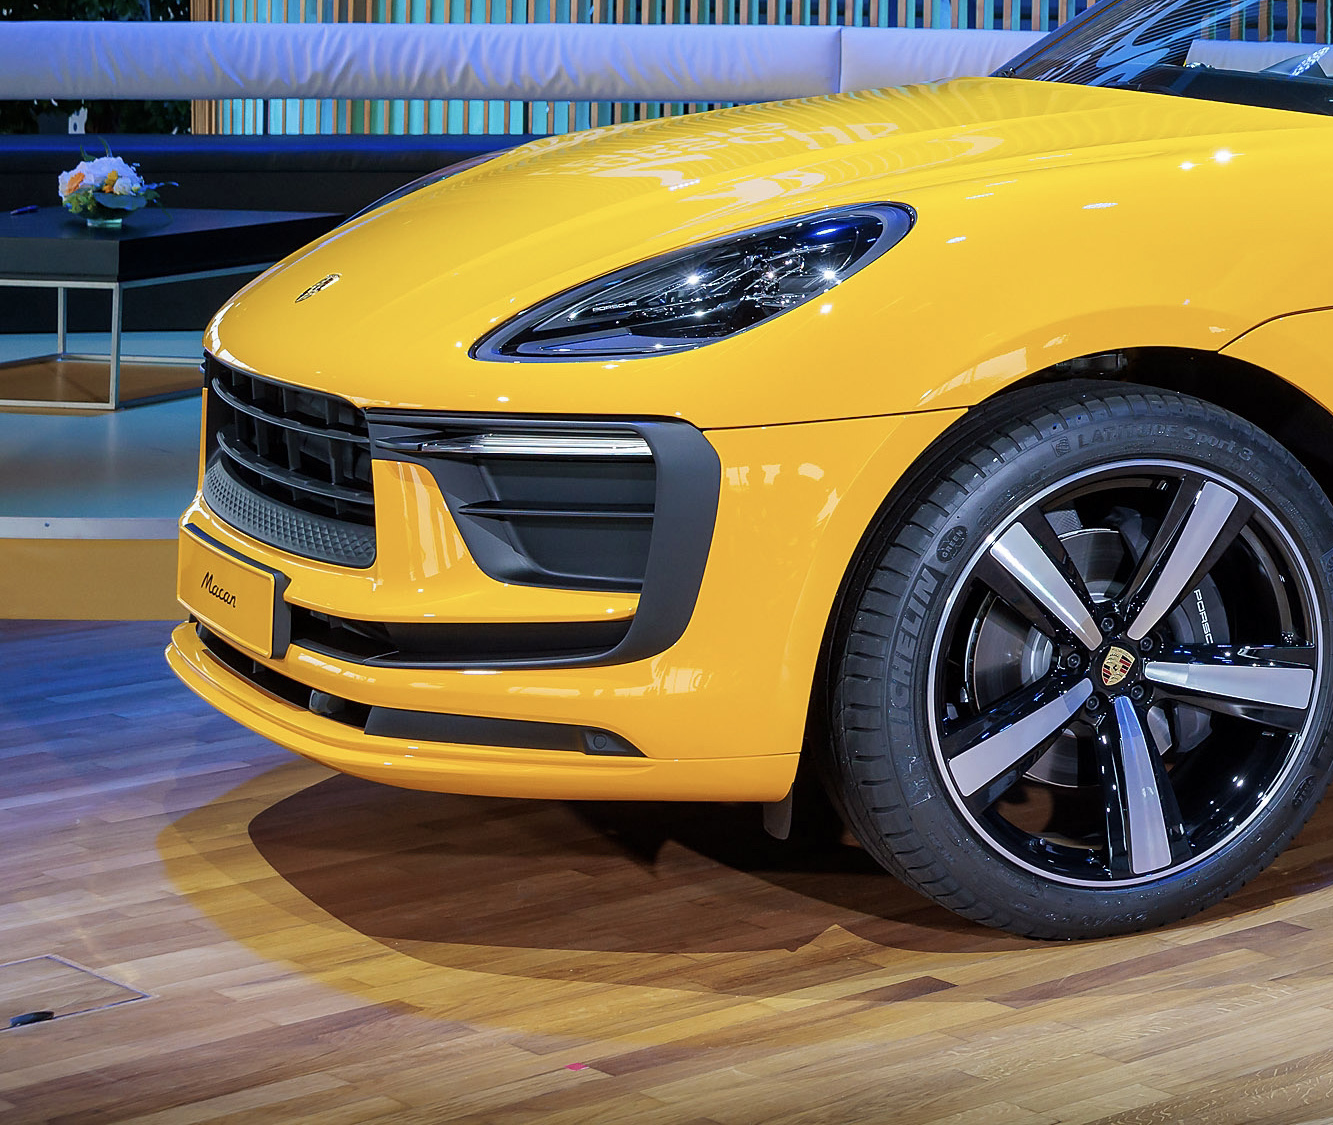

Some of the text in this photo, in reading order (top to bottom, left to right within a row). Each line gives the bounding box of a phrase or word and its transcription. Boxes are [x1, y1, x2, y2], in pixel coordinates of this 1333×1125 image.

[1184, 425, 1237, 453] Sport
[1238, 447, 1254, 461] 3
[941, 529, 964, 558] GREEN
[200, 571, 236, 608] Macan
[1193, 588, 1214, 644] PORSC
[889, 567, 939, 753] ICHELIN
